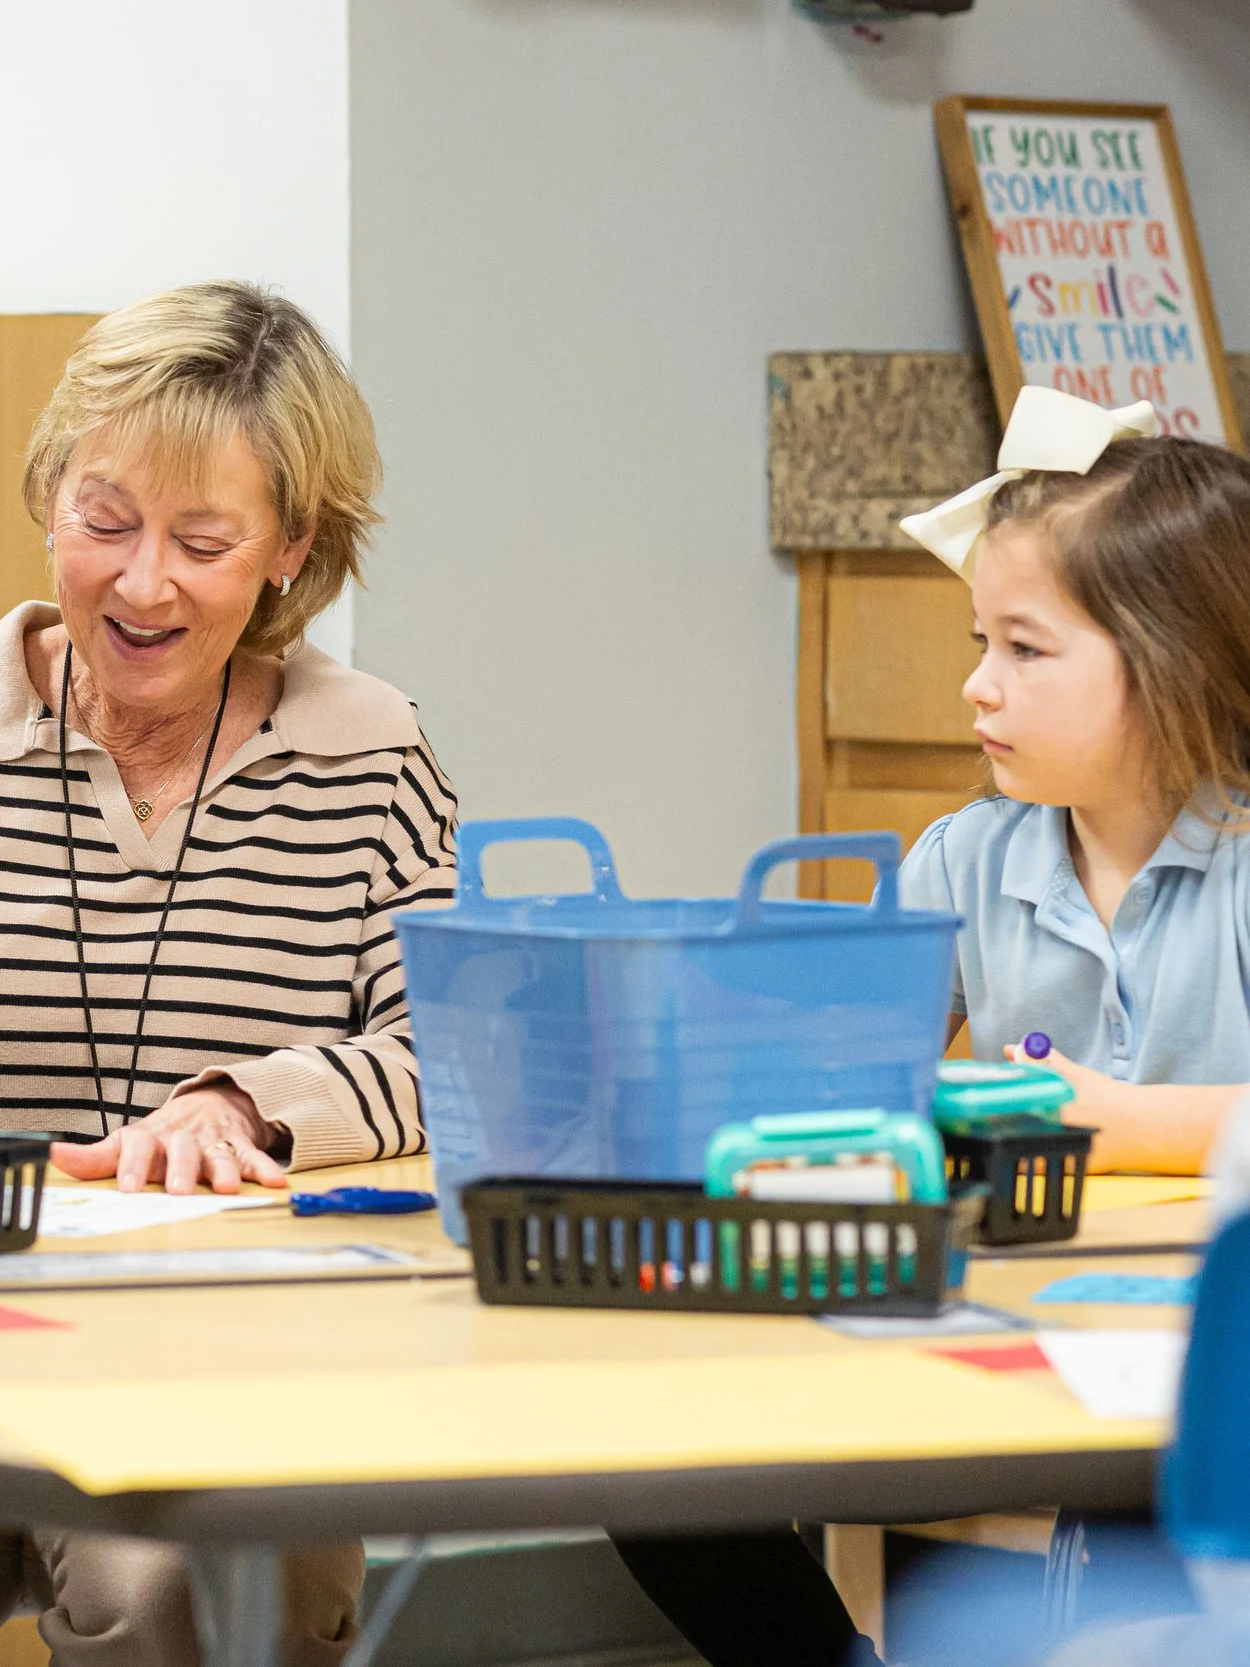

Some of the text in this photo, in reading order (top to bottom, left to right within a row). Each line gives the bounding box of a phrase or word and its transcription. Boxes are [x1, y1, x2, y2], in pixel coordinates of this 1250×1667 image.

[971, 124, 1146, 172] IF YOU SEE
[985, 171, 1150, 216] SOMEONE
[1015, 321, 1194, 365] GIVE THEM
[1129, 364, 1168, 406] OF
